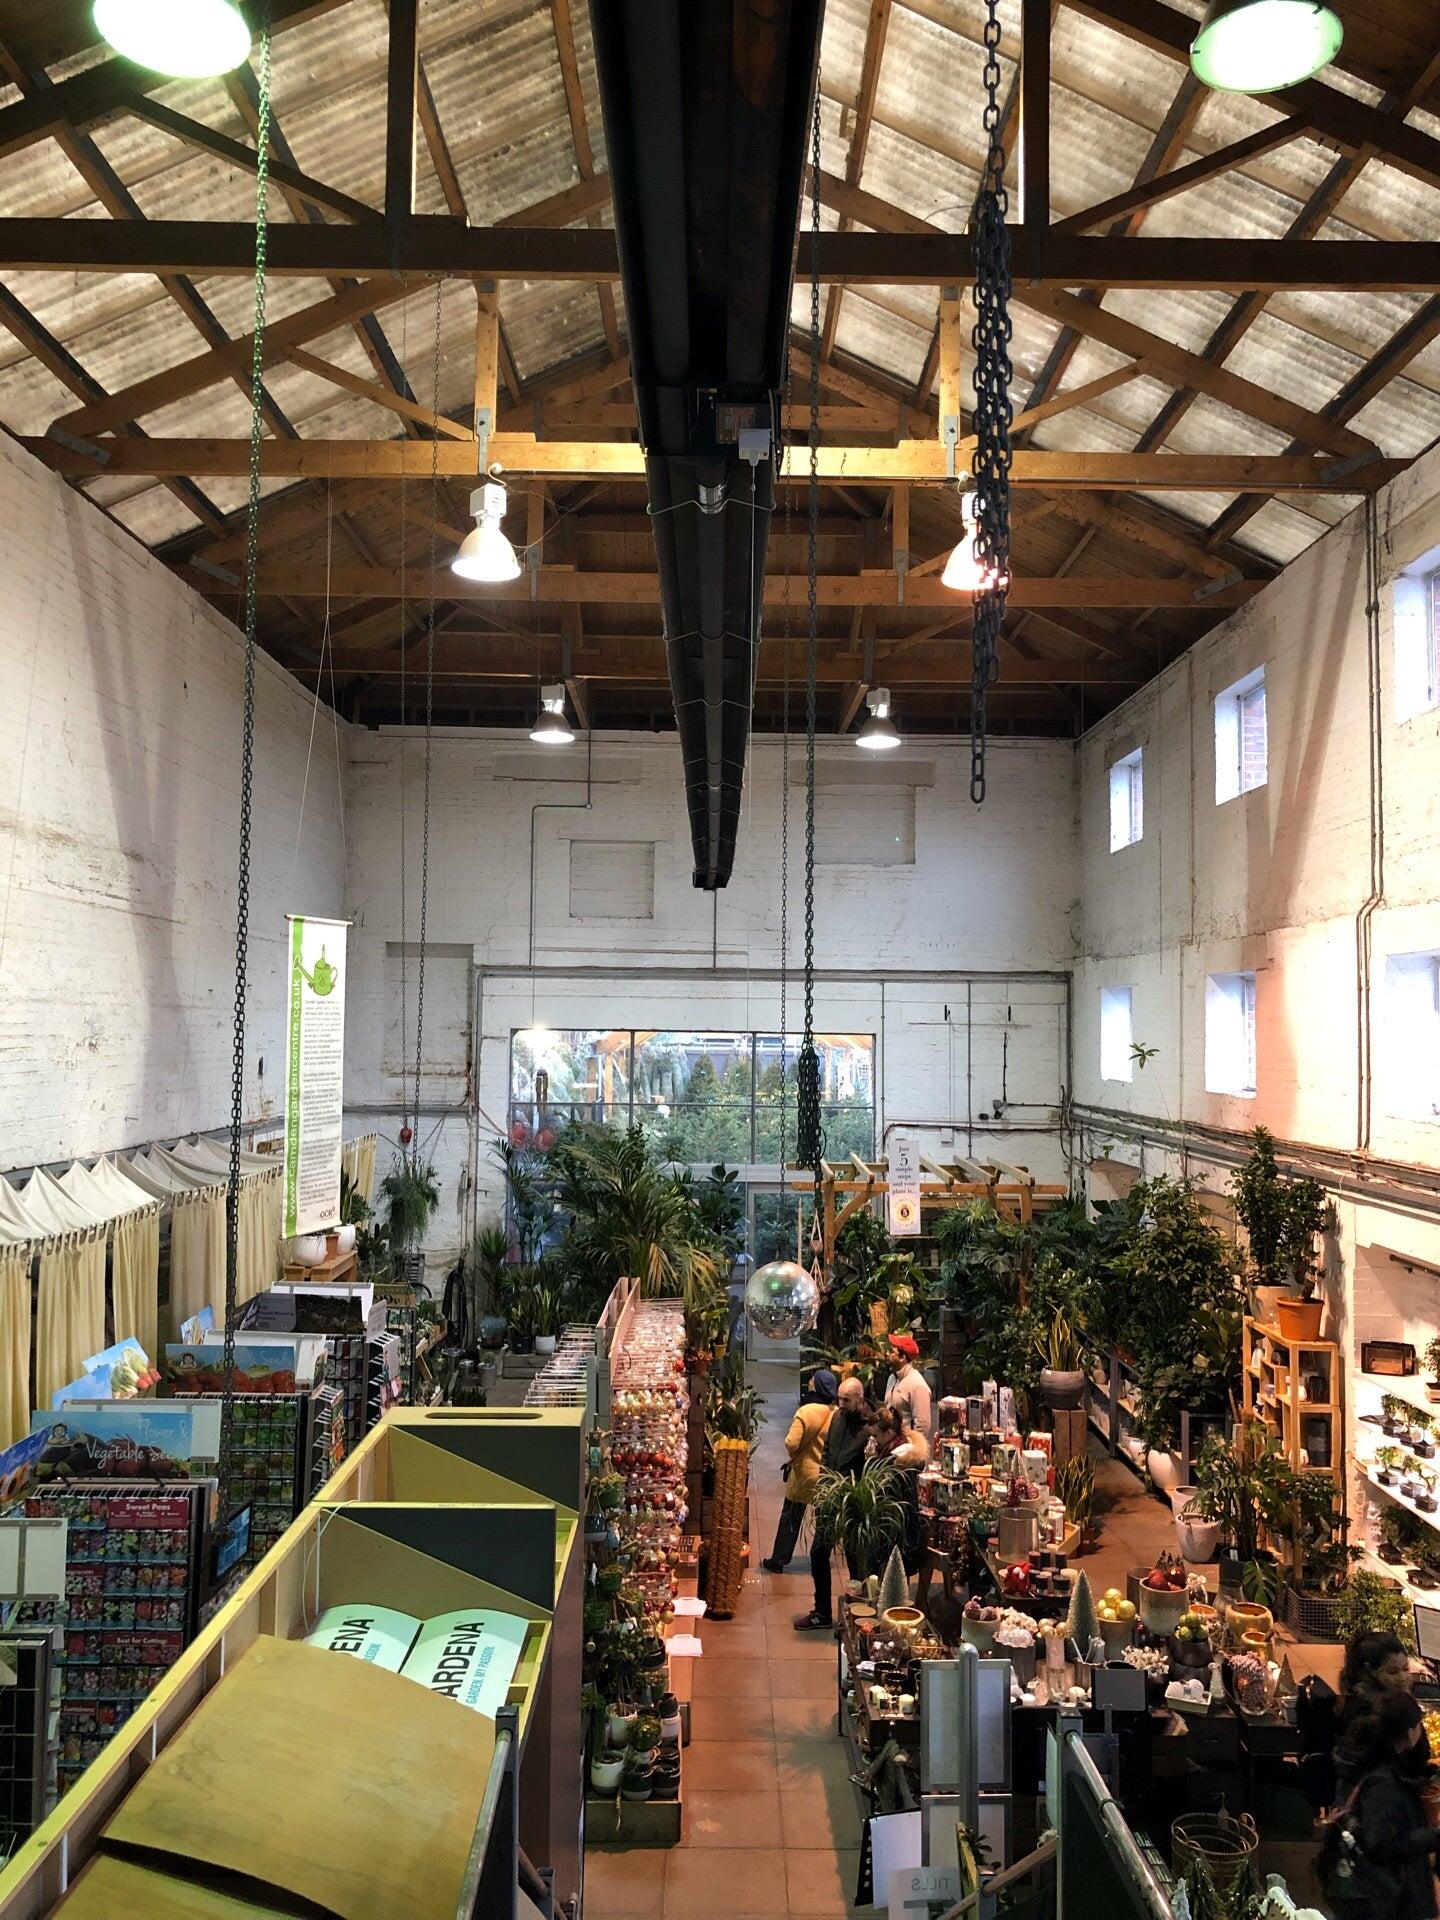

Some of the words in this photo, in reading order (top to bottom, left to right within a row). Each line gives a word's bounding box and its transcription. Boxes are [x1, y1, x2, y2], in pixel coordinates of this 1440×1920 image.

[289, 978, 301, 1219] www.camdengardencentre.co.uk
[900, 1153, 908, 1166] 5
[138, 1418, 174, 1439] Flower
[179, 1420, 188, 1439] &
[86, 1439, 145, 1469] Vegetable
[126, 1503, 150, 1511] Sweet
[152, 1503, 171, 1511] Peas
[329, 1618, 374, 1652] ENA
[431, 1622, 485, 1698] ARDENA
